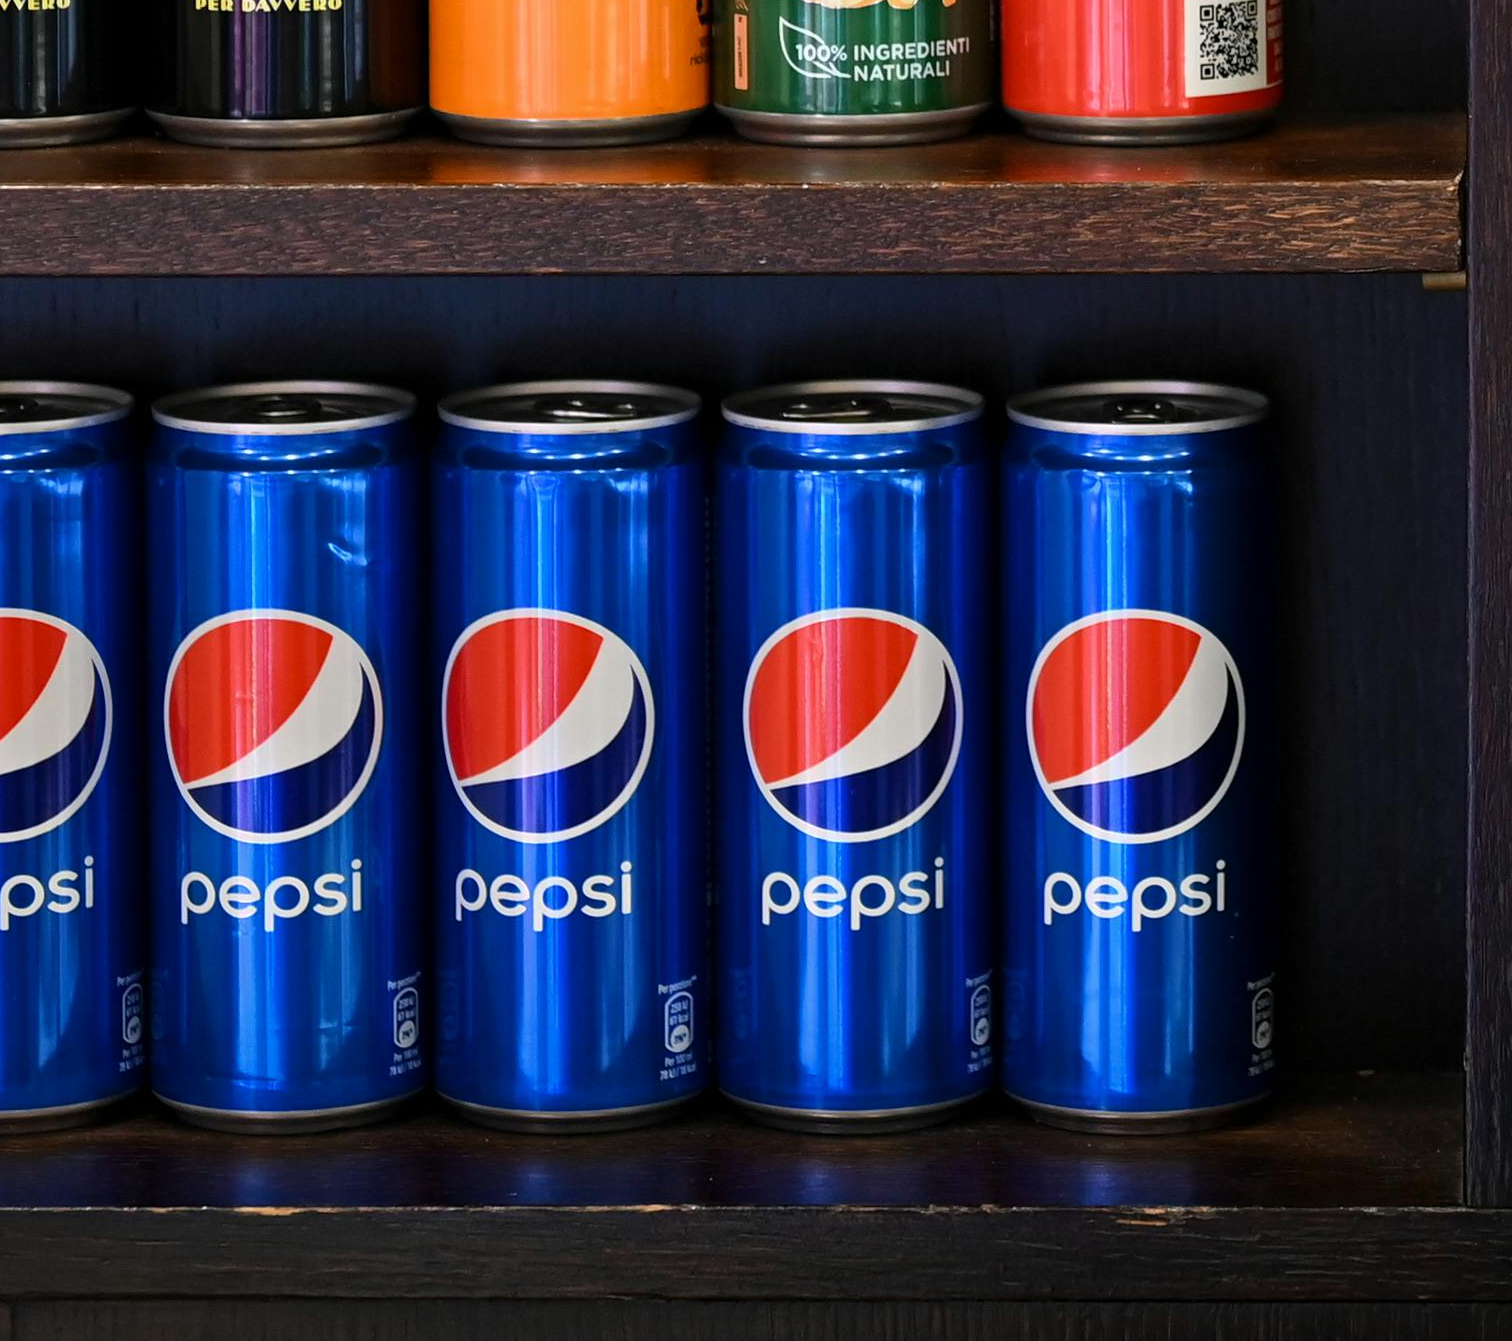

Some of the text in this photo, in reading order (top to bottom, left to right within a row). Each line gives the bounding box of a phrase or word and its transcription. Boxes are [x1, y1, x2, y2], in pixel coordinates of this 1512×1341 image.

[180, 858, 362, 932] pepsi
[455, 861, 633, 932] pepsi
[761, 857, 944, 931] pepsi
[1043, 859, 1226, 932] pepsi
